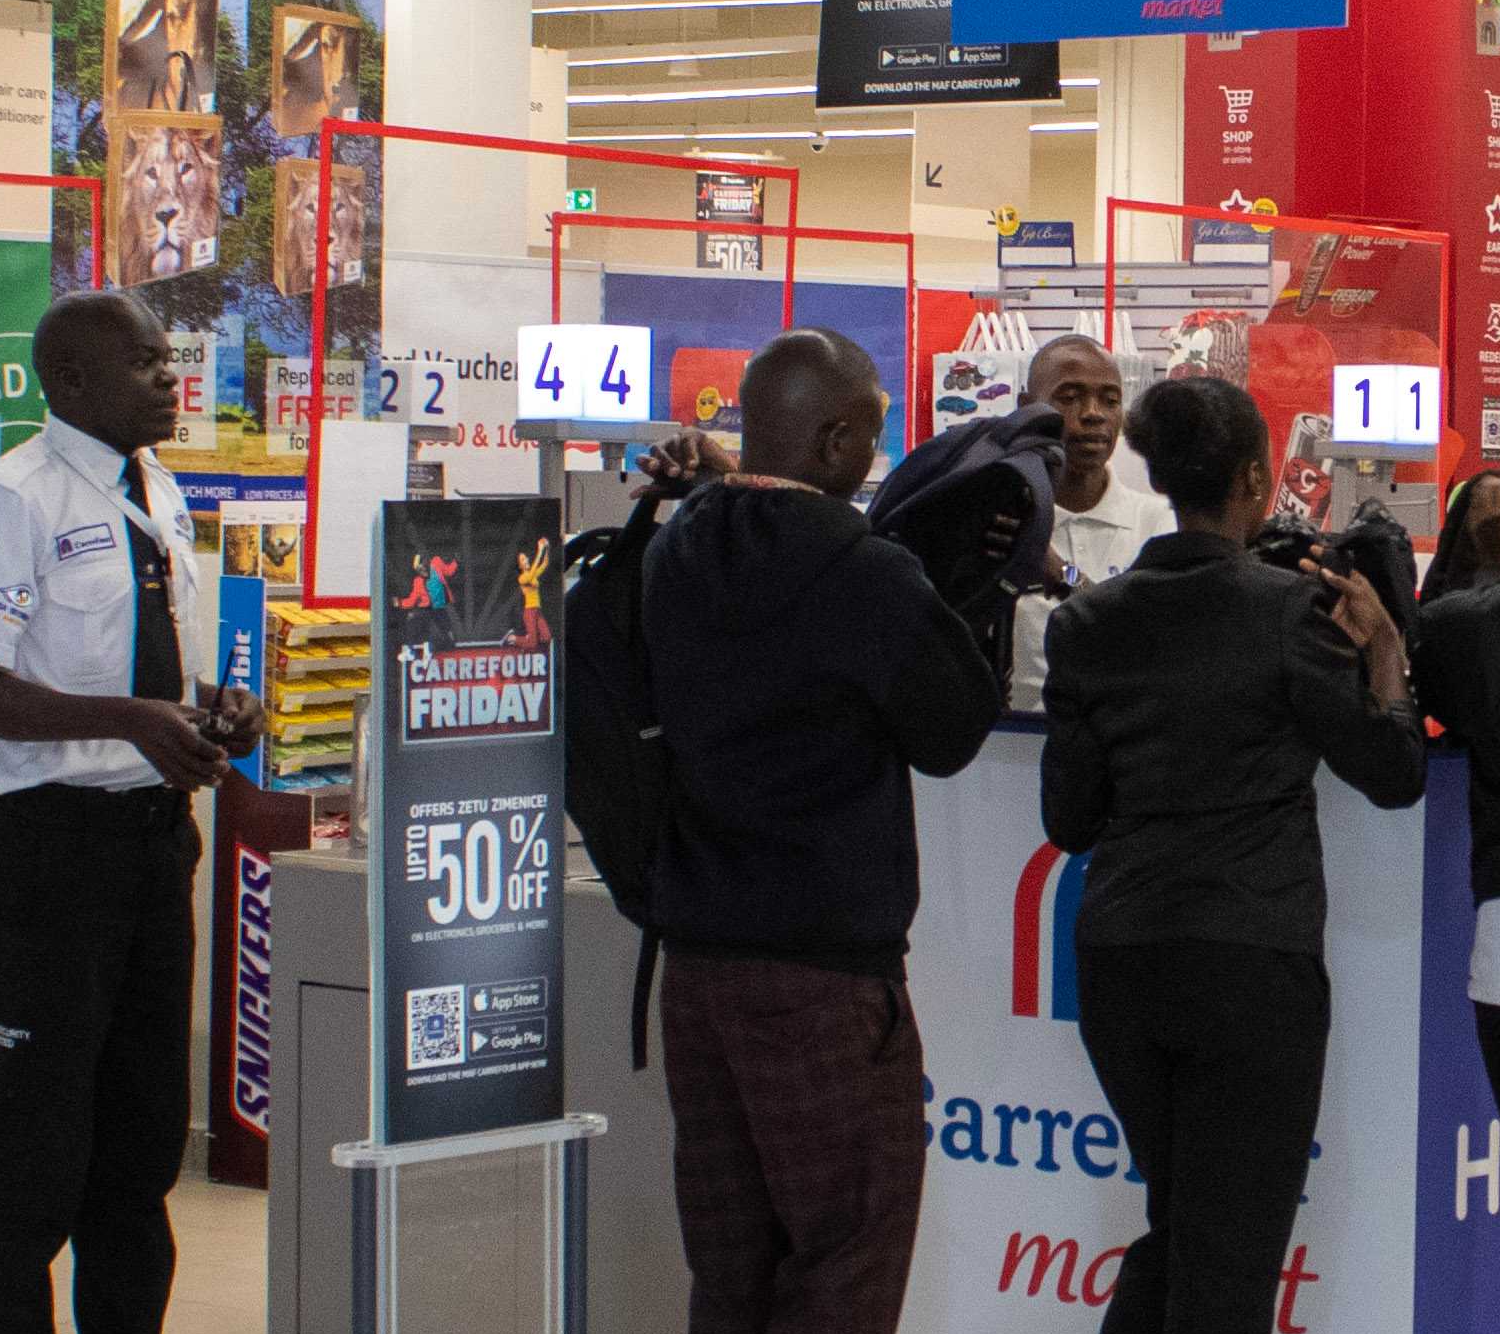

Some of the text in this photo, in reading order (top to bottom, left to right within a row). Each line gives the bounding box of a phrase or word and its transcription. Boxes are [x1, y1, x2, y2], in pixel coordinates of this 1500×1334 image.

[18, 86, 47, 100] care
[1222, 130, 1253, 144] SHOP
[410, 653, 546, 684] CARREFOUR
[410, 682, 546, 731] FRIDAY
[410, 797, 489, 819] OFFERS ZETU
[507, 871, 550, 911] OFF
[234, 855, 271, 1131] SNICKERS
[491, 992, 539, 1011] App Store
